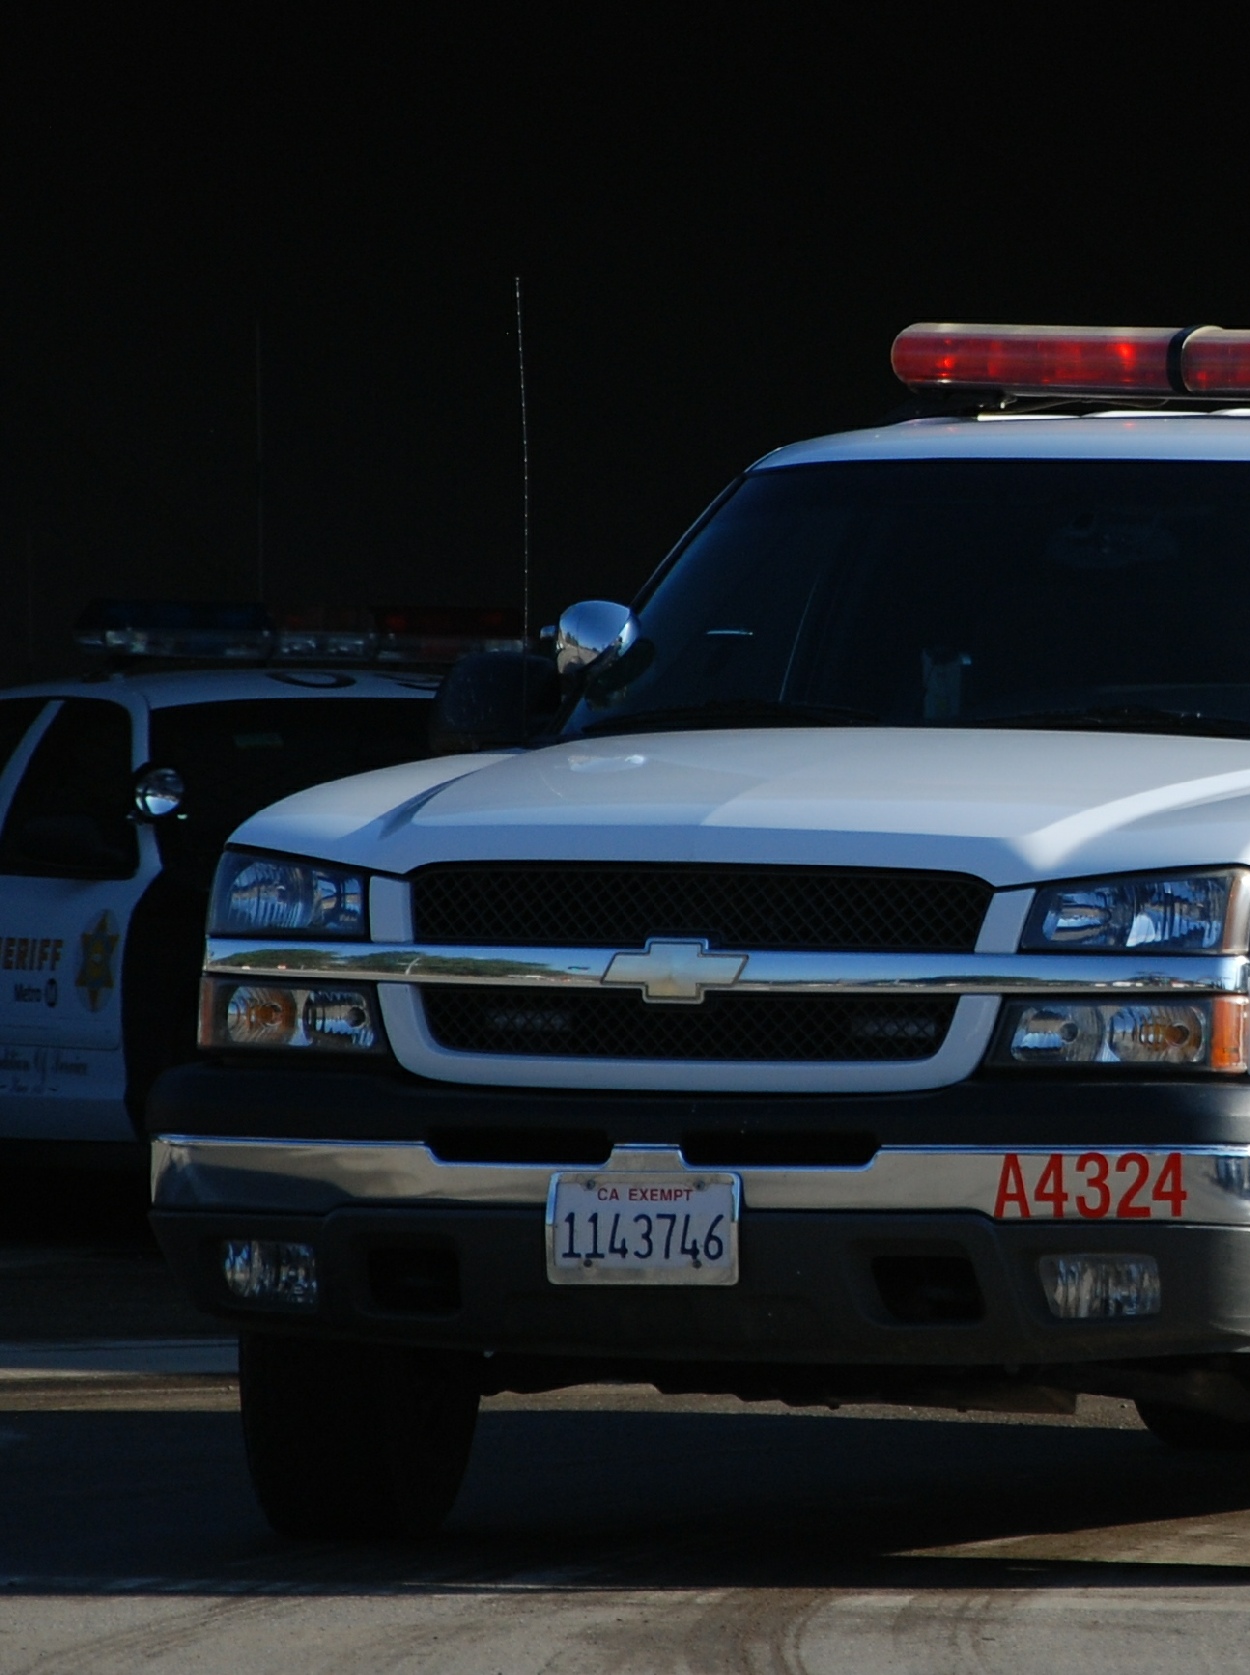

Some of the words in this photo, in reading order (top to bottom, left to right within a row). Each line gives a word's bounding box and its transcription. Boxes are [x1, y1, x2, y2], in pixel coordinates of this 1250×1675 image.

[0, 937, 63, 971] ERIFF
[597, 1187, 619, 1201] CA
[628, 1188, 693, 1202] EXEMPT
[994, 1152, 1187, 1219] A4324
[562, 1211, 724, 1260] 1143746
